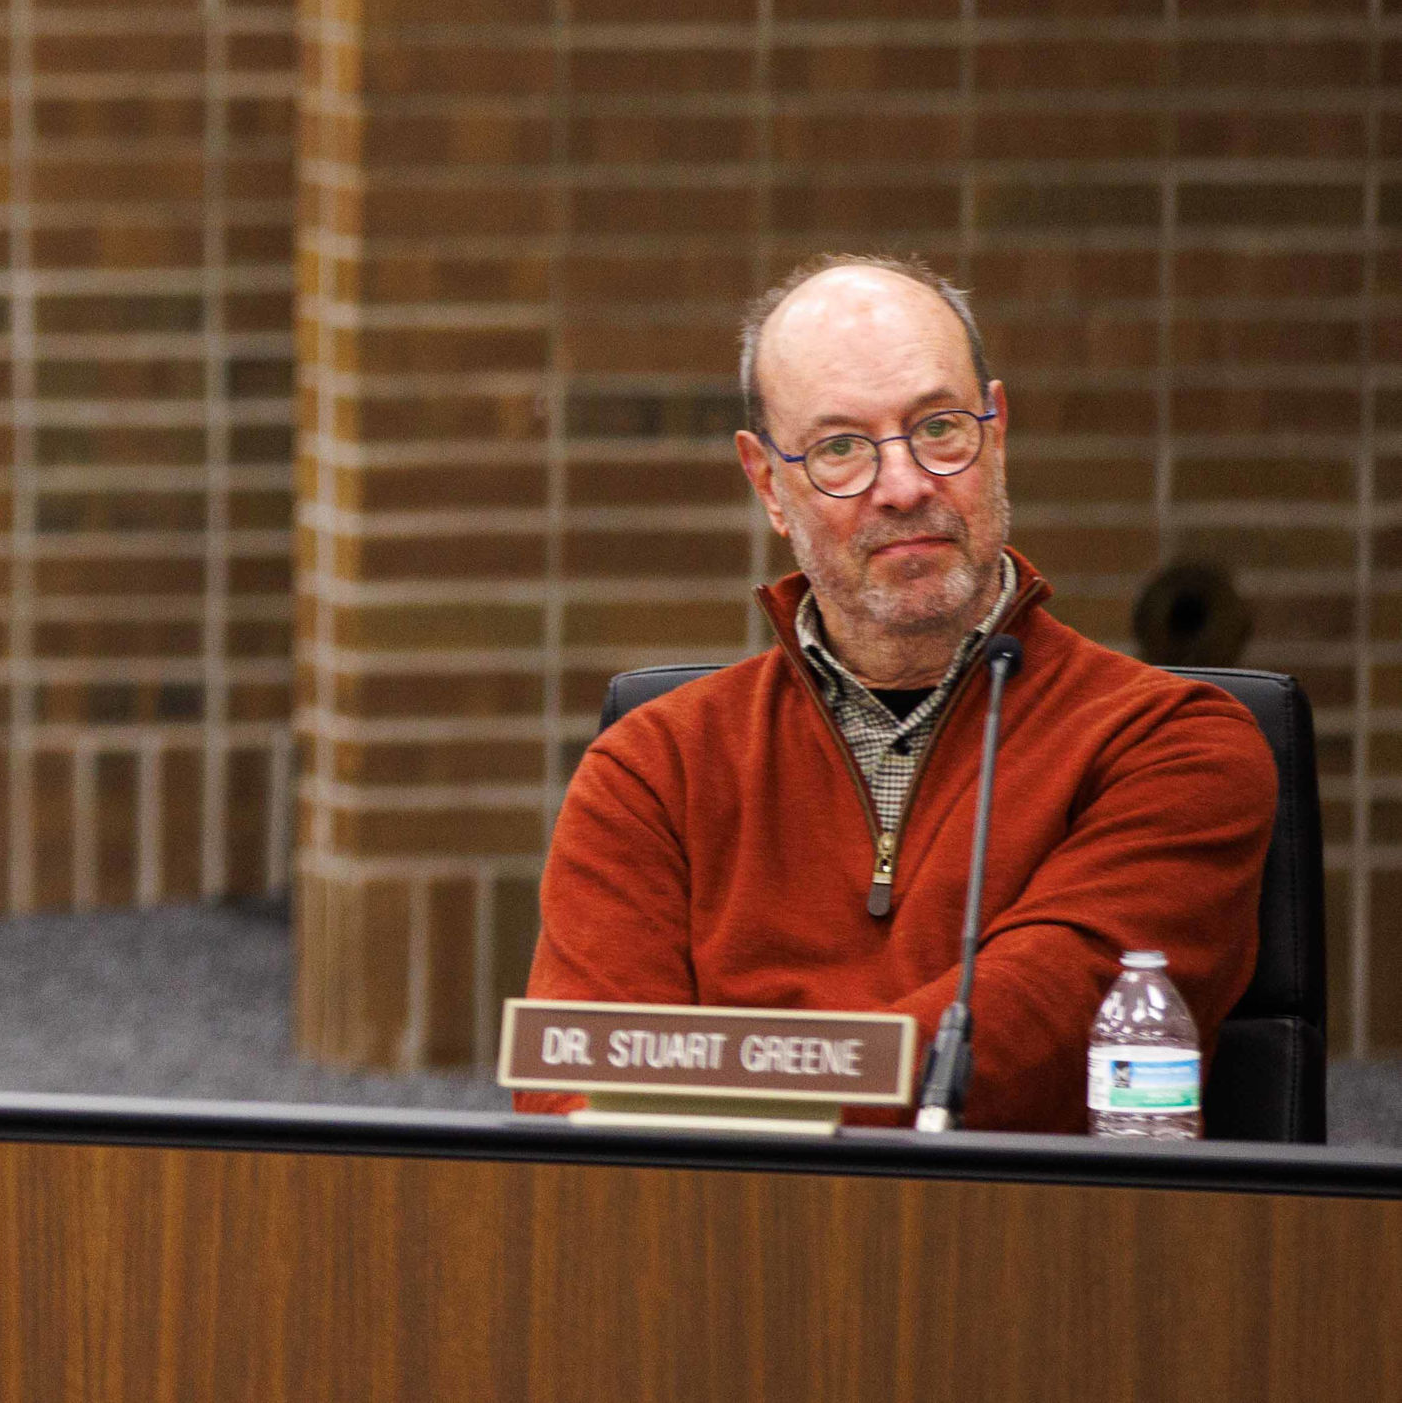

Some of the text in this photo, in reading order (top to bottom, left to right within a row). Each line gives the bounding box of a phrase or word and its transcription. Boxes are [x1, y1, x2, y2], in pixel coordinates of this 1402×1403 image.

[541, 1026, 865, 1077] DR. STUART GREENE
